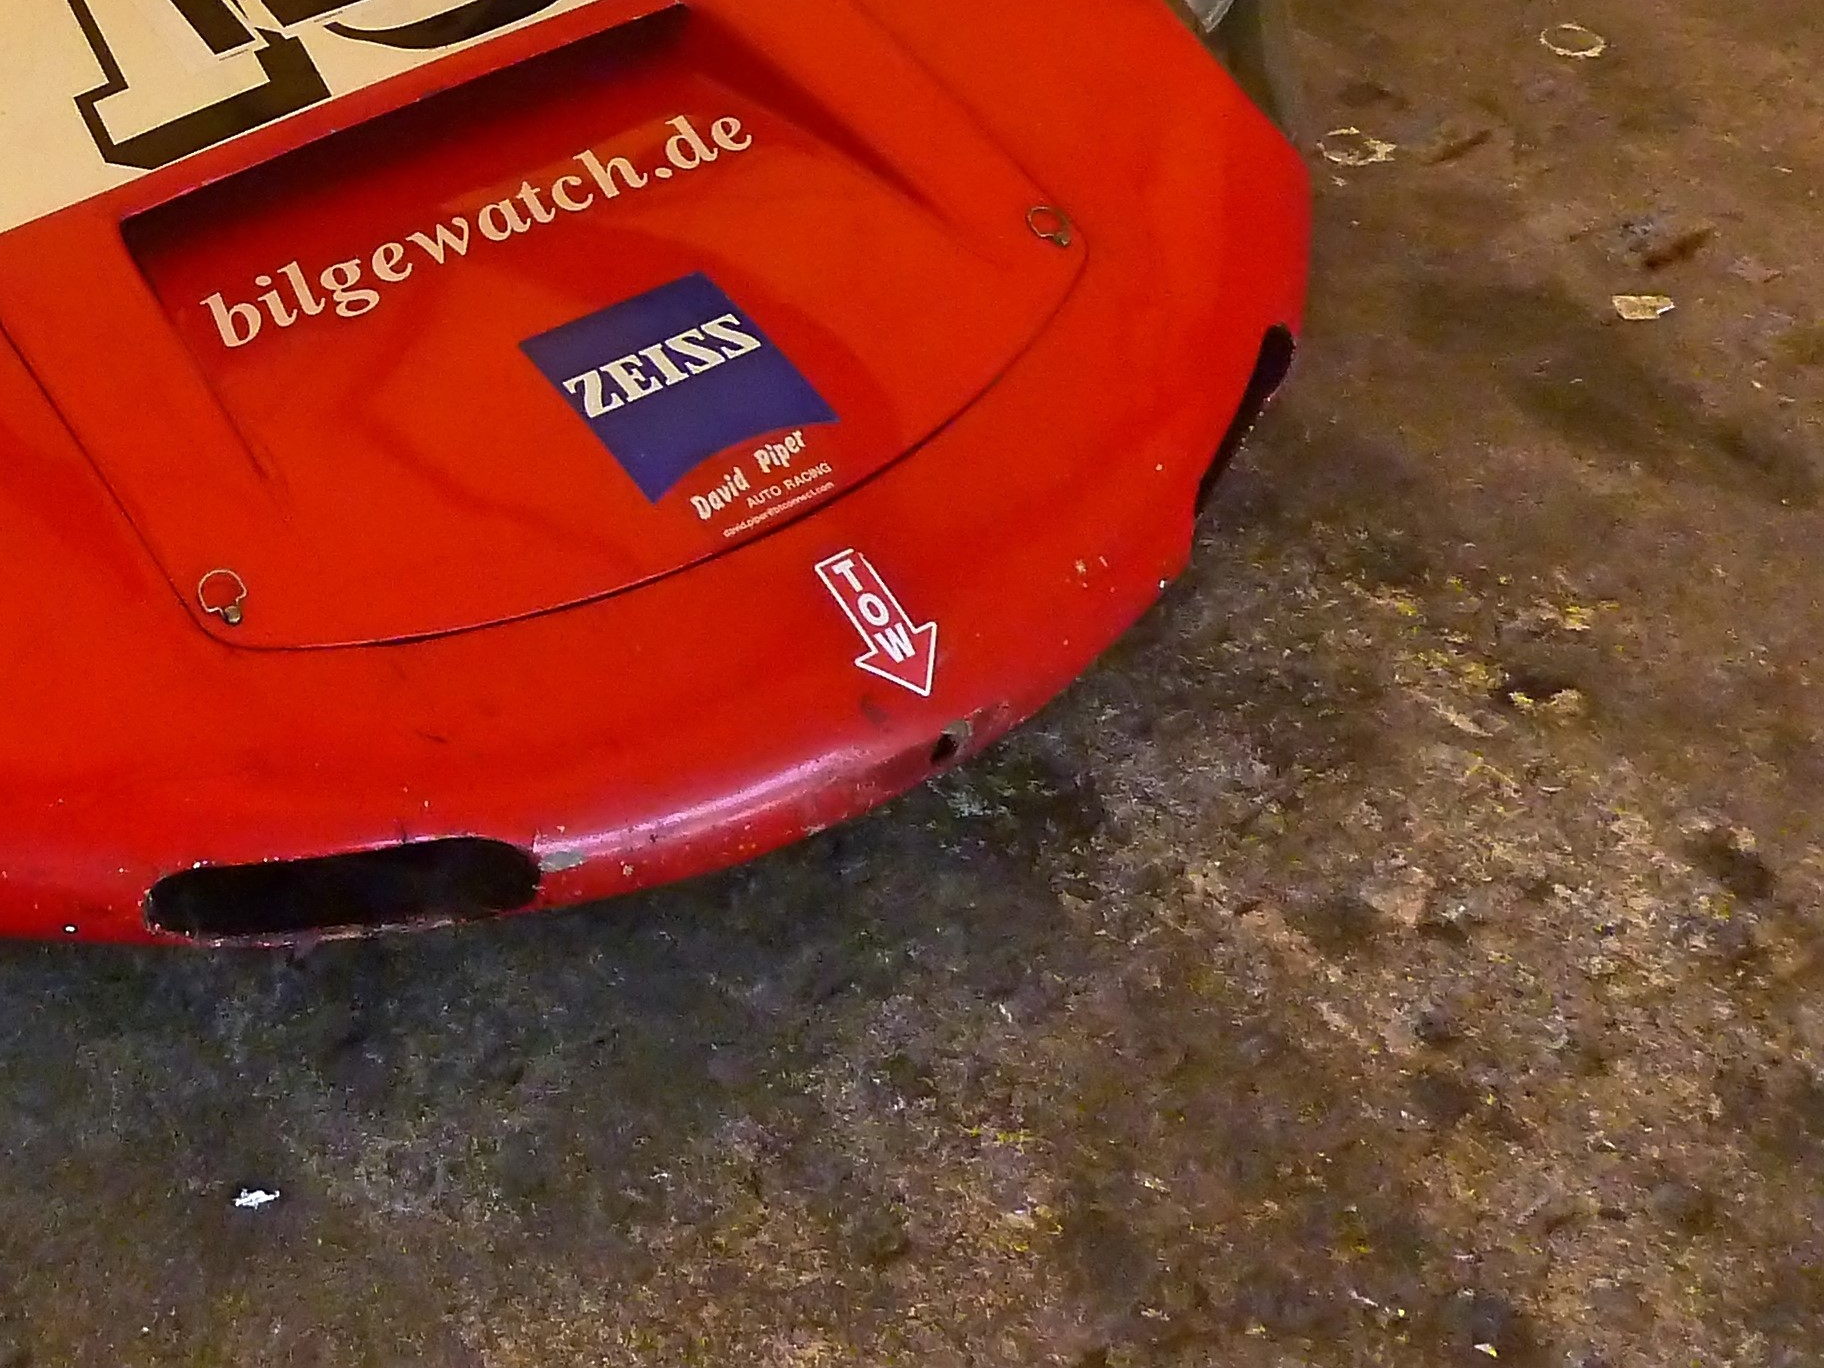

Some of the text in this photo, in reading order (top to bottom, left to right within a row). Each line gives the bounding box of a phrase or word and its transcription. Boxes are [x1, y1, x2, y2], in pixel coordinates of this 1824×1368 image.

[198, 110, 754, 350] bilgewatch.de
[561, 312, 764, 419] ZEISS
[689, 429, 806, 521] David Piper
[746, 462, 833, 509] AUTO RACING
[831, 559, 916, 665] TOW
